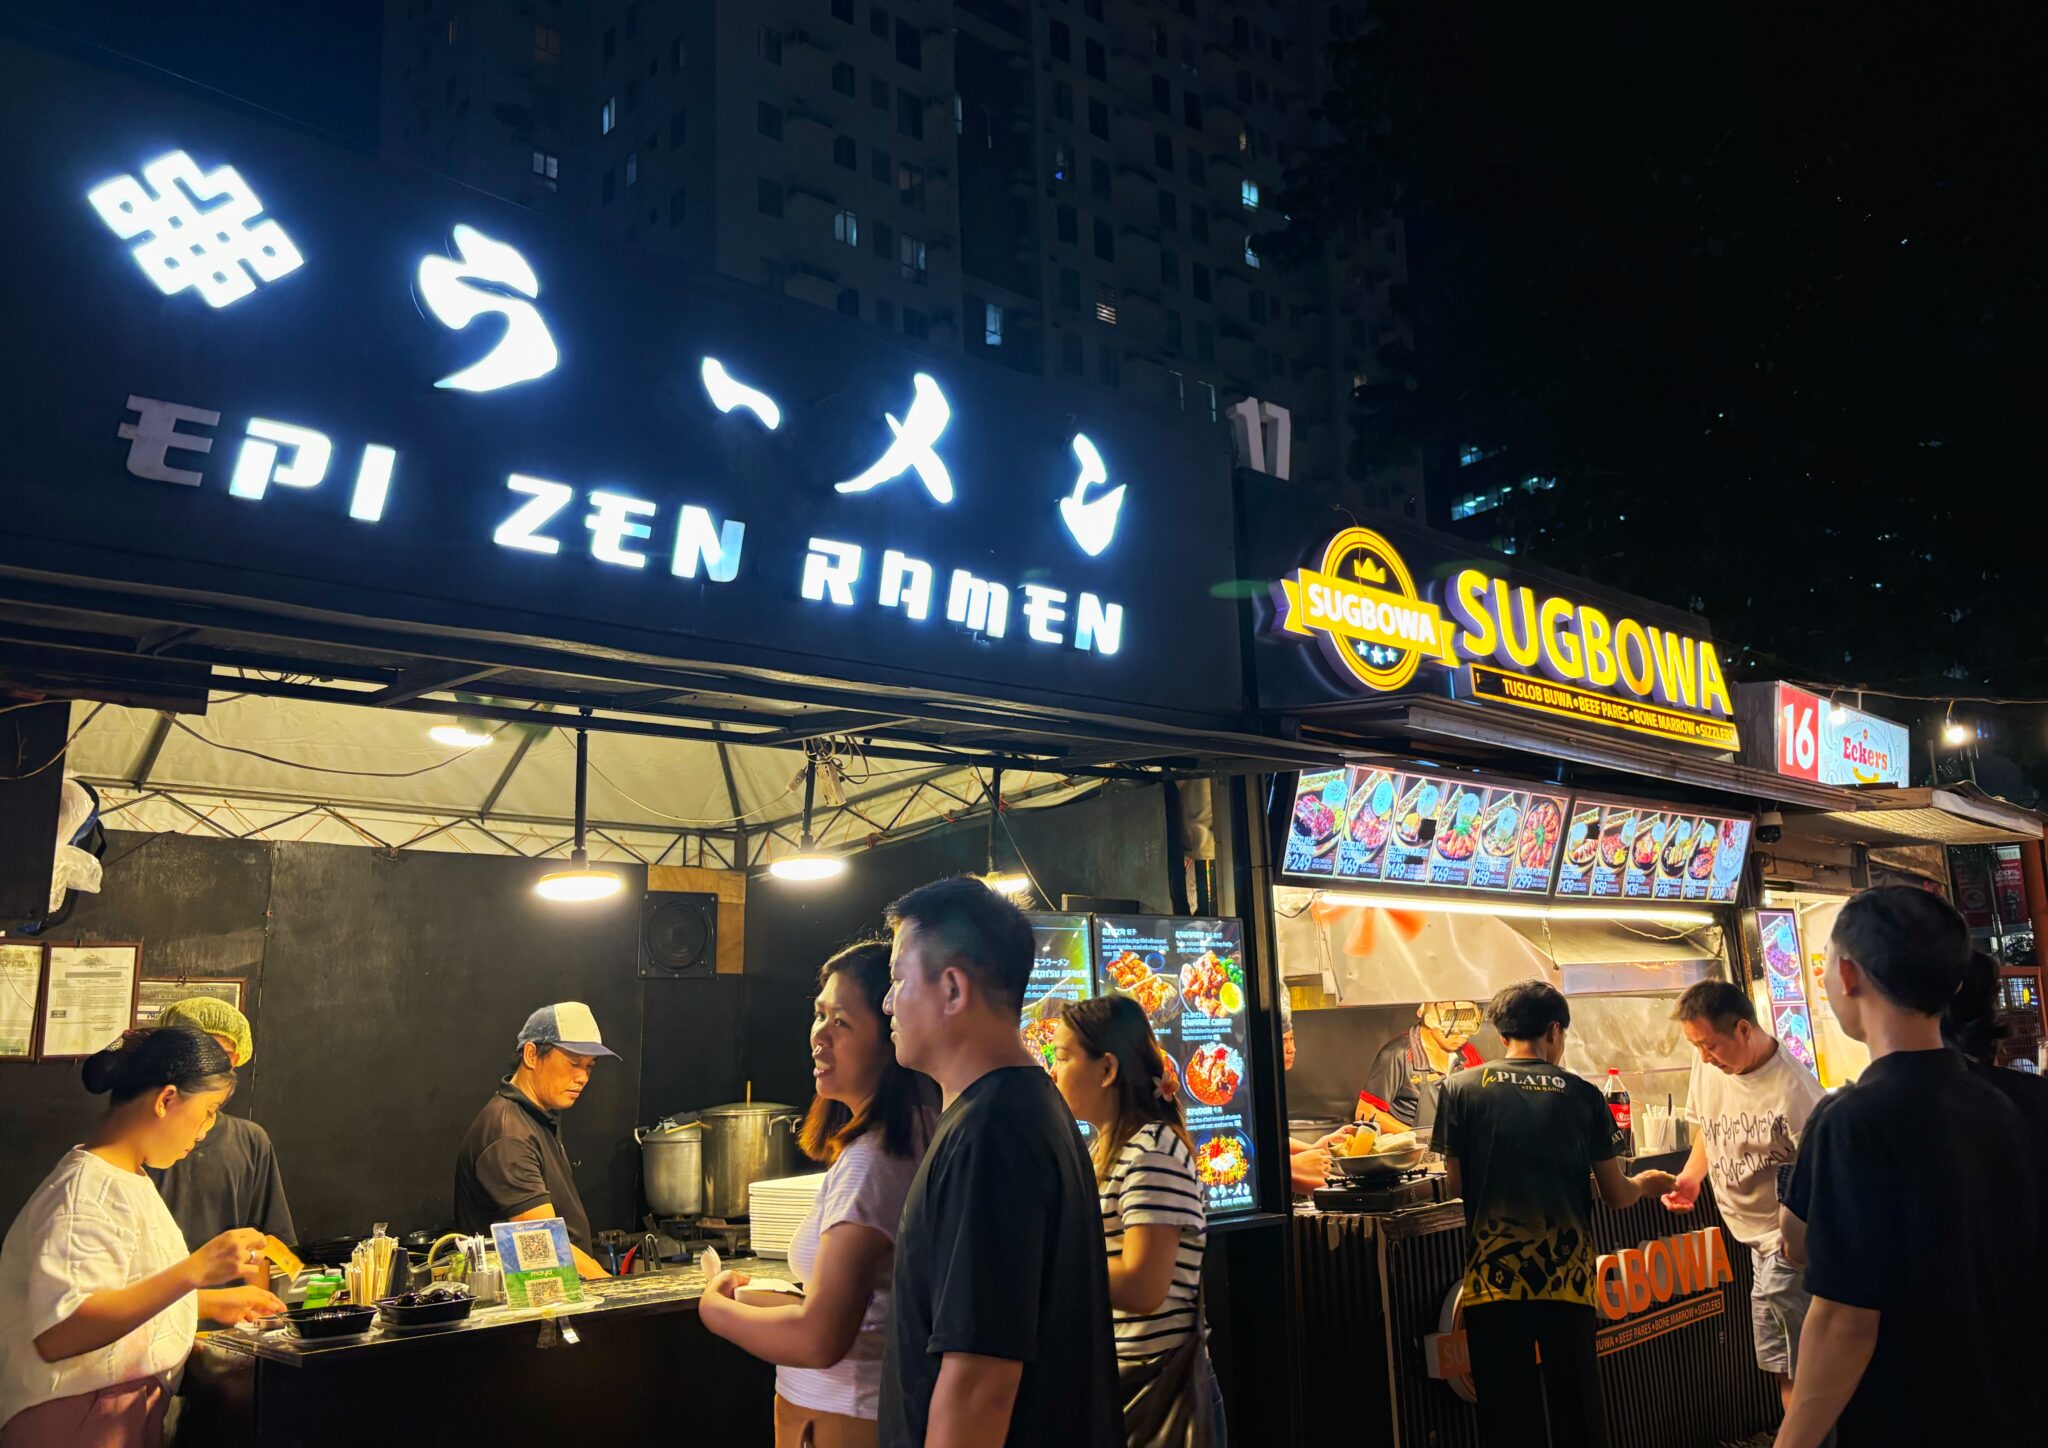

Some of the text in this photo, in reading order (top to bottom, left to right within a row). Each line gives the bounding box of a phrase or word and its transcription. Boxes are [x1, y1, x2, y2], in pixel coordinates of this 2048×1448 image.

[1226, 396, 1291, 481] 17
[116, 392, 1124, 656] EPI ZEN RAMEN
[1307, 581, 1435, 646] SUGBOWA
[1456, 567, 1734, 716] SUGBOWA
[1502, 678, 1735, 742] TUSLOB BUWA BEEF PARES BONE MARROW SIZZLERS
[1783, 702, 1815, 770] 16
[1842, 736, 1888, 771] Eckers
